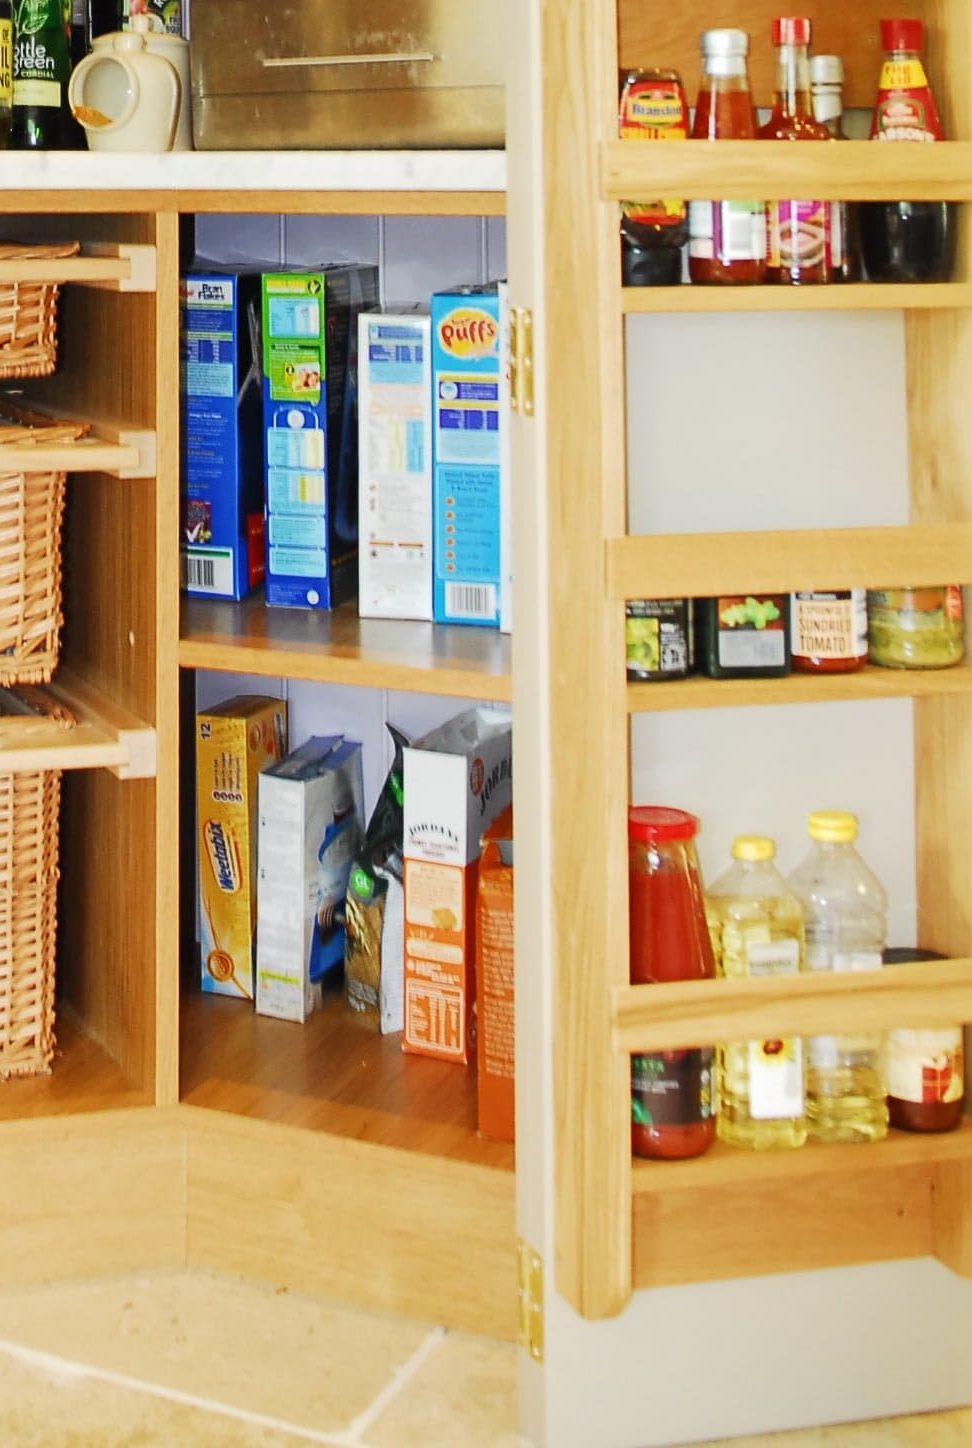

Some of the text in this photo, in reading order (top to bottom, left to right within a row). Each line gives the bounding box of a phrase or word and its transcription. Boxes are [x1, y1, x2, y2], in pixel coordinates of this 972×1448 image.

[13, 39, 46, 59] ottle
[20, 70, 56, 79] CORDIAL
[198, 292, 225, 301] Flakes
[202, 283, 223, 293] Bran
[799, 617, 851, 634] SUNDRIED
[799, 635, 846, 652] TOMATO
[201, 722, 211, 740] 12
[208, 816, 235, 891] Weetabix
